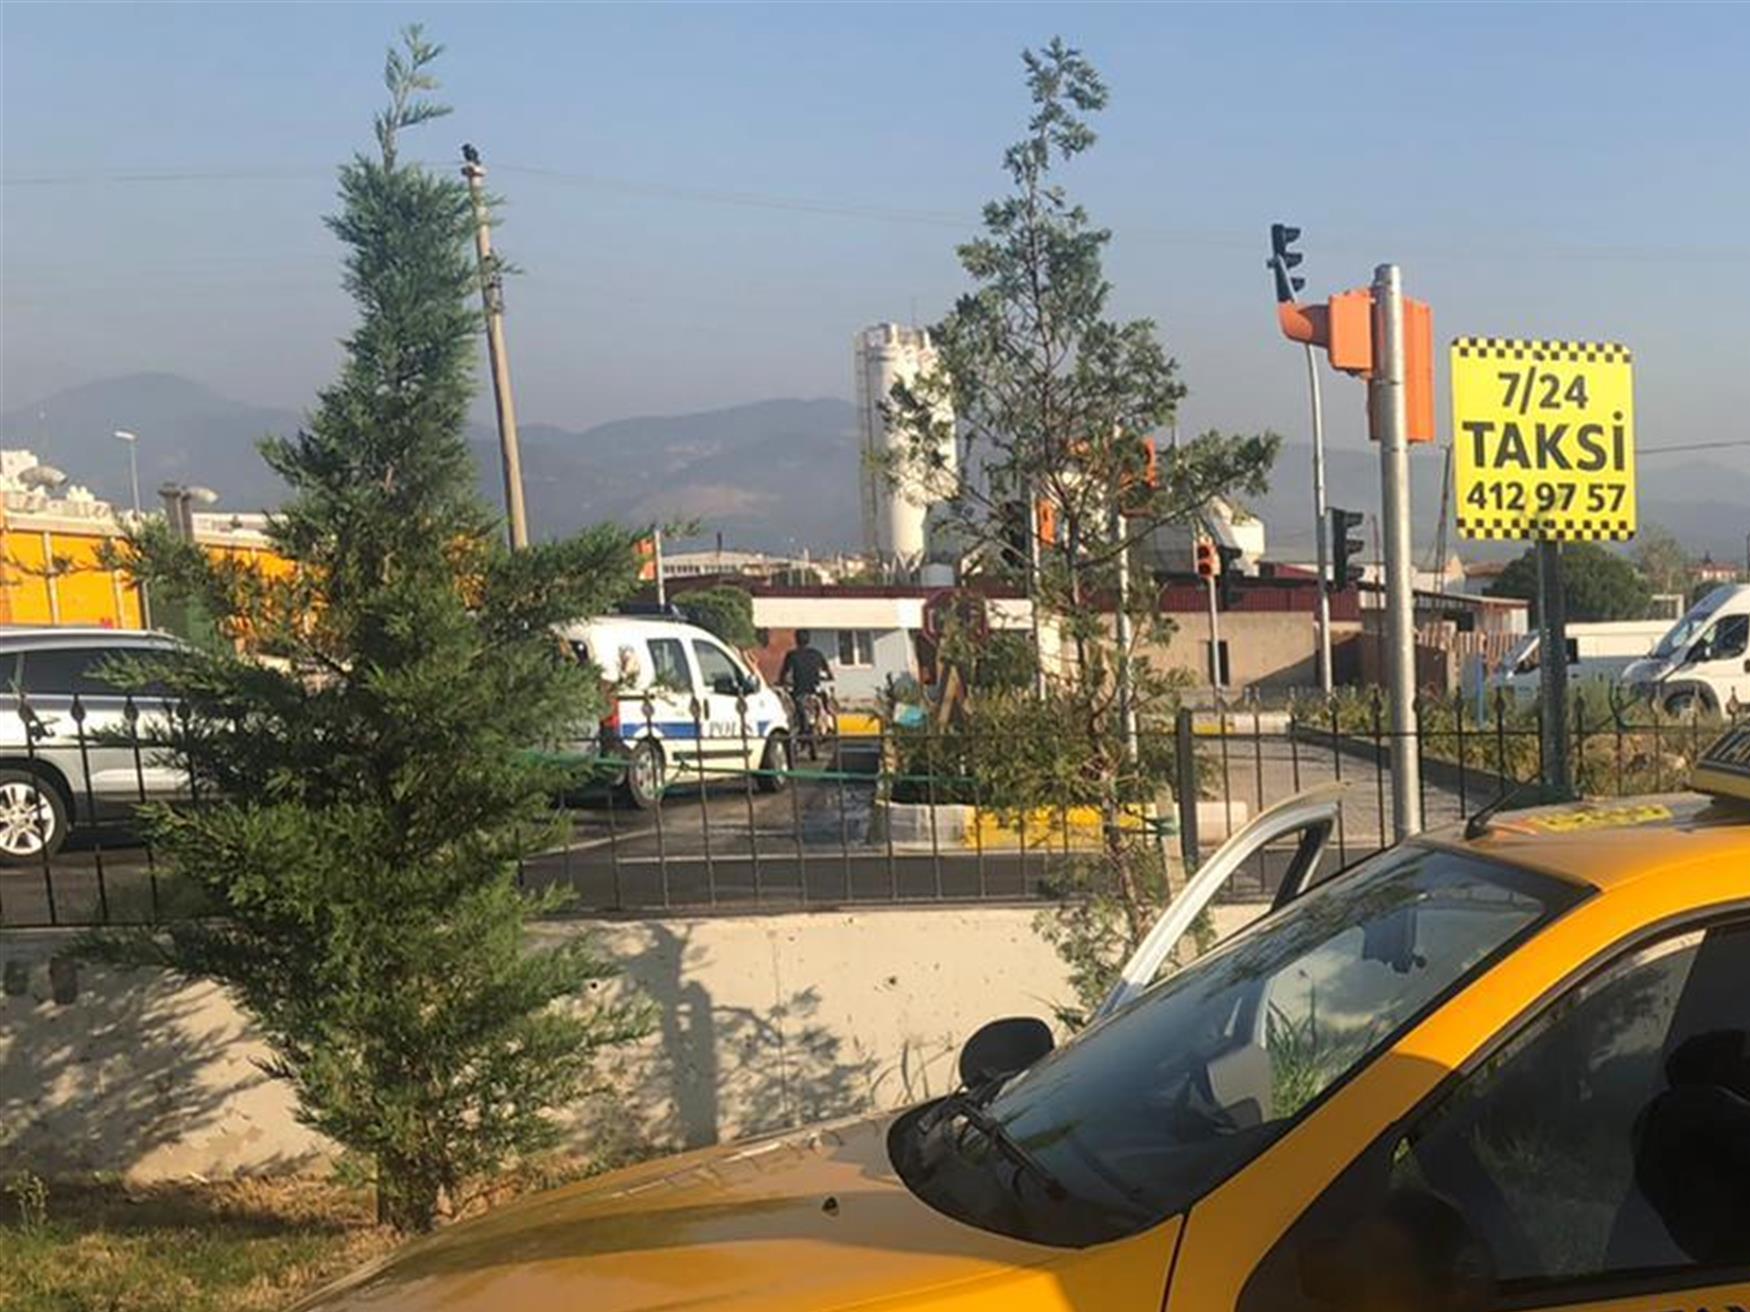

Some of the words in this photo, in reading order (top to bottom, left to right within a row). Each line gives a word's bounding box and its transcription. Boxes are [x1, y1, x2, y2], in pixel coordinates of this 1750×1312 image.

[1498, 366, 1589, 415] 7/24
[1462, 411, 1625, 471] TAKSİ
[1466, 481, 1525, 510] 412
[1535, 482, 1576, 512] 97
[1587, 484, 1626, 512] 57
